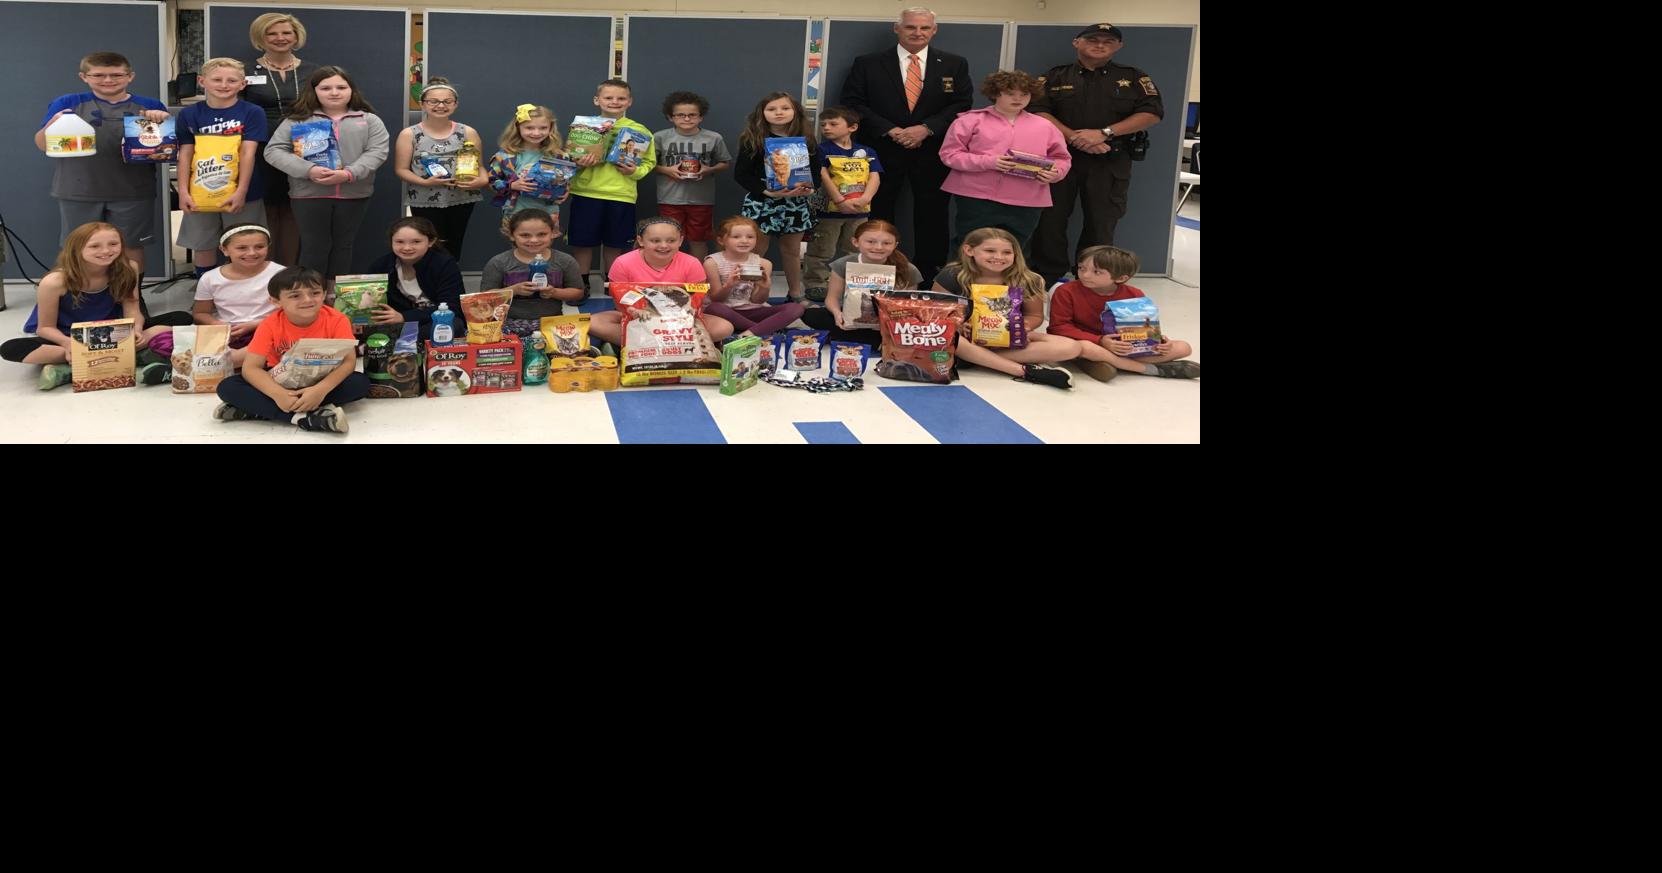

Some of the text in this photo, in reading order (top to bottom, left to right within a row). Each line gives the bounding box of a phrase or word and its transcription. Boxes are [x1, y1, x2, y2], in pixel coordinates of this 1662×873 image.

[667, 143, 694, 155] ALL
[197, 158, 215, 169] Cat
[197, 164, 225, 177] Litter
[979, 315, 1003, 323] Meow
[653, 327, 693, 336] GRAVY
[894, 322, 947, 337] Meaty
[101, 342, 116, 350] Roy
[901, 335, 947, 346] Bone
[448, 352, 466, 360] Roy
